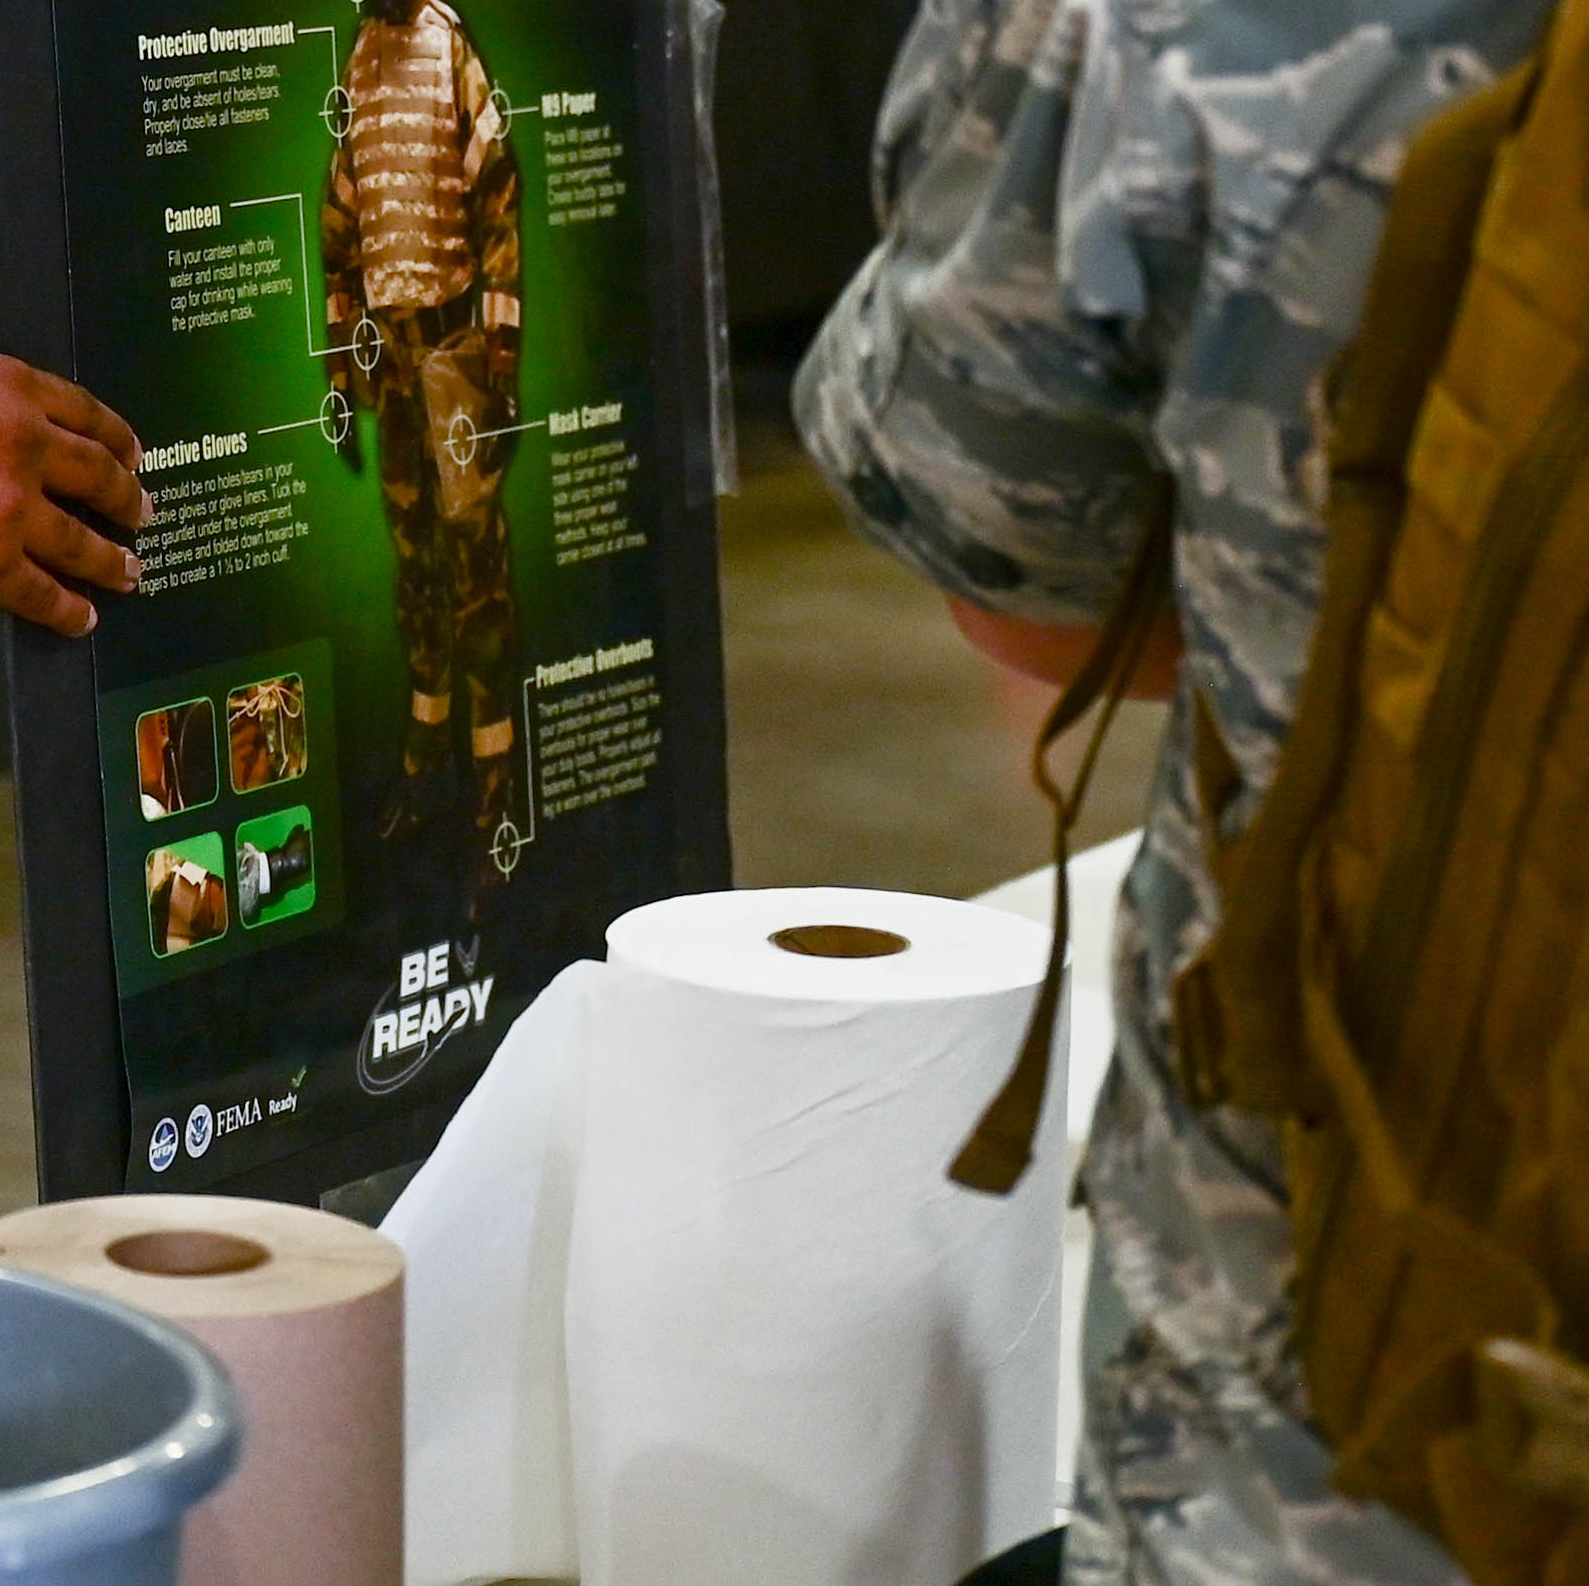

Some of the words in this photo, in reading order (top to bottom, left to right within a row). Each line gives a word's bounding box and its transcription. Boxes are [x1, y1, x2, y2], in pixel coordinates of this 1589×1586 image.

[138, 29, 208, 61] Protective
[209, 21, 295, 52] Overgarment
[141, 75, 162, 92] Your
[164, 70, 218, 92] overgarment
[219, 65, 240, 82] must
[241, 65, 253, 80] be
[254, 63, 280, 79] clean,
[143, 97, 160, 117] dry,
[162, 94, 178, 112] and
[179, 93, 191, 109] be
[192, 89, 222, 108] absent
[223, 87, 232, 104] of
[144, 116, 180, 136] Properly
[219, 109, 229, 126] all
[230, 106, 270, 124] fasteners
[146, 138, 163, 157] and
[165, 205, 221, 233] Canteen
[168, 249, 181, 267] Fill
[182, 250, 202, 269] your
[202, 244, 237, 262] canteen
[238, 238, 256, 255] with
[257, 235, 275, 255] only
[169, 271, 193, 288] water
[194, 266, 211, 285] and
[213, 262, 237, 281] install
[238, 261, 252, 278] the
[254, 258, 282, 278] proper
[171, 295, 187, 312] cap
[188, 290, 201, 307] for
[201, 286, 235, 305] drinking
[236, 282, 258, 299] while
[260, 277, 293, 295] wearing
[172, 315, 186, 332] the
[187, 308, 229, 332] protective
[549, 407, 579, 436] Mask
[581, 401, 622, 429] Carrier
[139, 439, 200, 474] rotective
[202, 431, 248, 461] Gloves
[161, 480, 190, 503] should
[191, 479, 203, 496] be
[204, 478, 216, 493] no
[265, 463, 274, 480] in
[274, 462, 293, 483] your
[178, 503, 207, 525] gloves
[208, 500, 218, 514] or
[219, 494, 243, 516] glove
[271, 483, 291, 500] Tuck
[292, 479, 307, 495] the
[135, 533, 160, 556] glove
[161, 524, 196, 550] gauntlet
[197, 519, 222, 537] under
[224, 514, 238, 530] the
[239, 503, 293, 528] overgarment
[138, 552, 163, 573] acket
[165, 549, 193, 567] sleeve
[195, 540, 211, 559] and
[212, 536, 239, 556] folded
[240, 530, 264, 549] down
[265, 524, 295, 543] toward
[295, 521, 309, 536] the
[138, 575, 168, 597] fingers
[170, 572, 179, 587] to
[180, 565, 208, 585] create
[209, 564, 215, 578] a
[217, 559, 222, 576] 1
[234, 556, 244, 572] to
[244, 552, 251, 570] 2
[252, 549, 271, 567] inch
[536, 654, 594, 689] Protective
[596, 638, 654, 672] Overboots
[400, 941, 450, 1000] BE
[372, 975, 494, 1061] READY
[216, 1097, 262, 1137] FEMA
[269, 1091, 297, 1116] Ready
